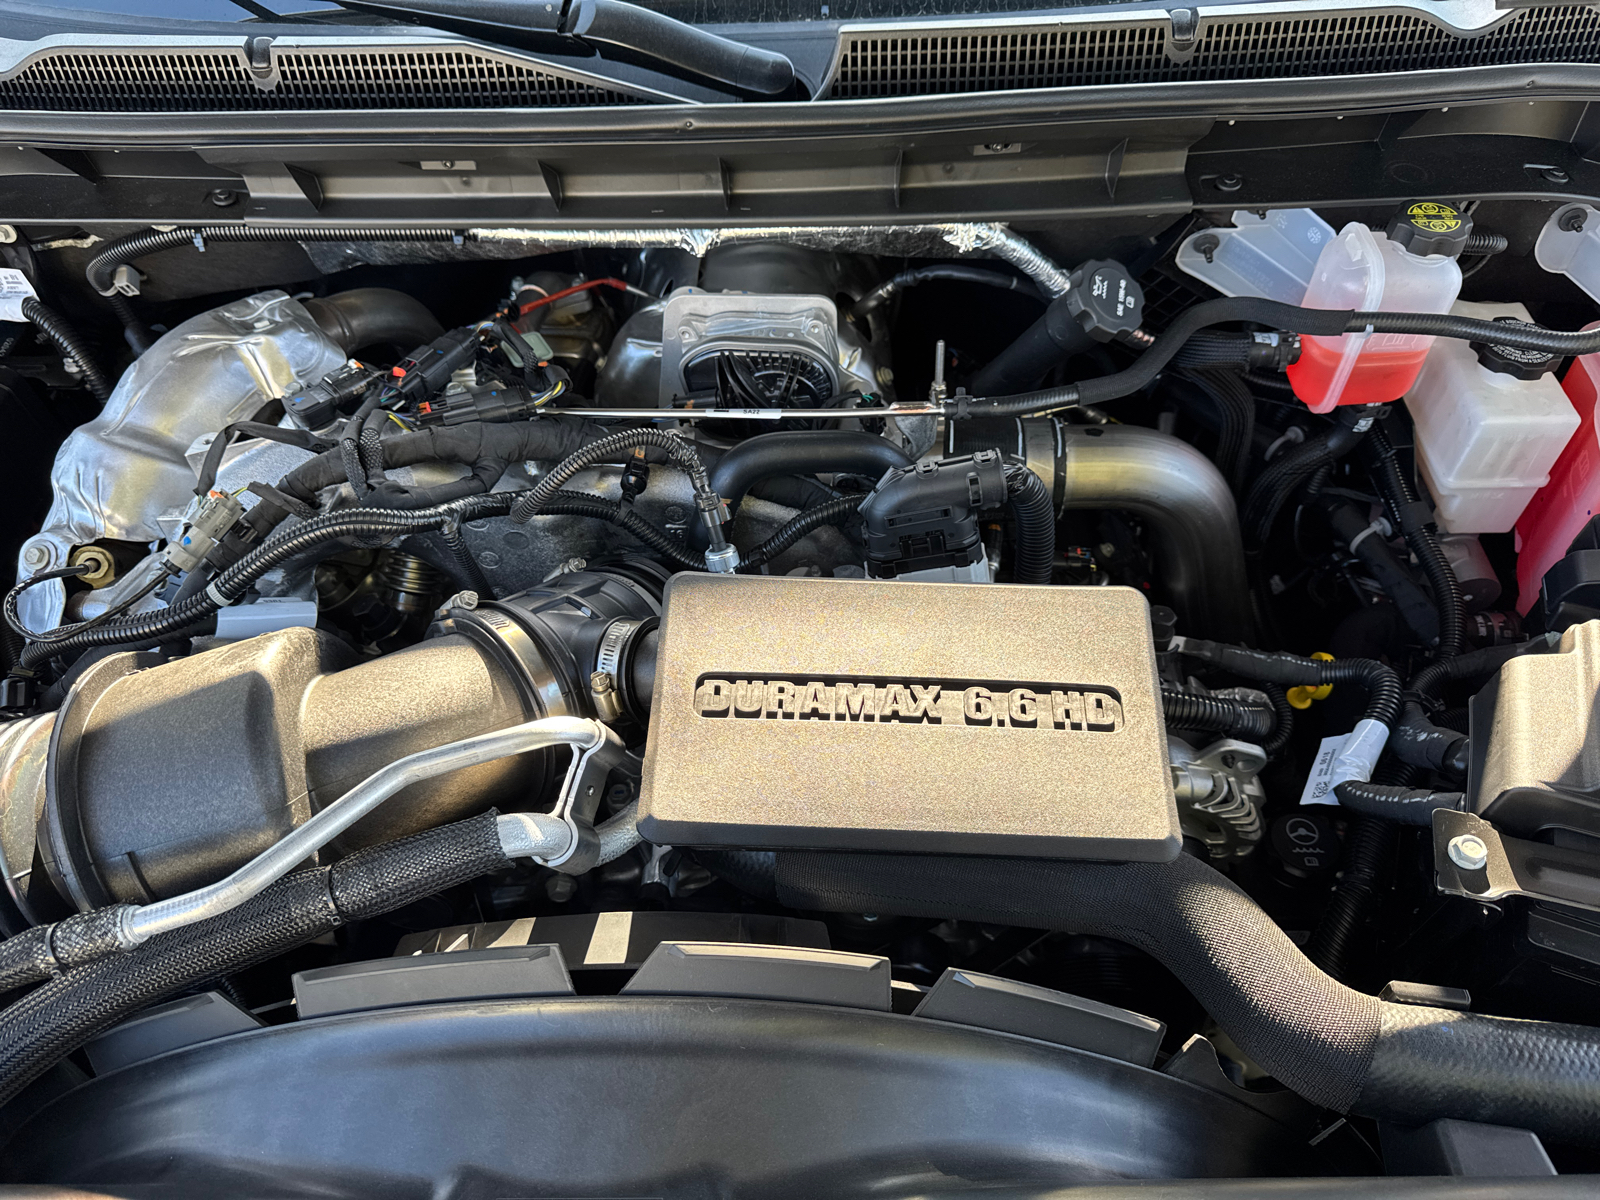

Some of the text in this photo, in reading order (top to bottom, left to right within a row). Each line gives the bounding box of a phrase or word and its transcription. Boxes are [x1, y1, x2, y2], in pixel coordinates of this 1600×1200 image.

[700, 679, 1117, 730] DURAMAX 6.6 HD
